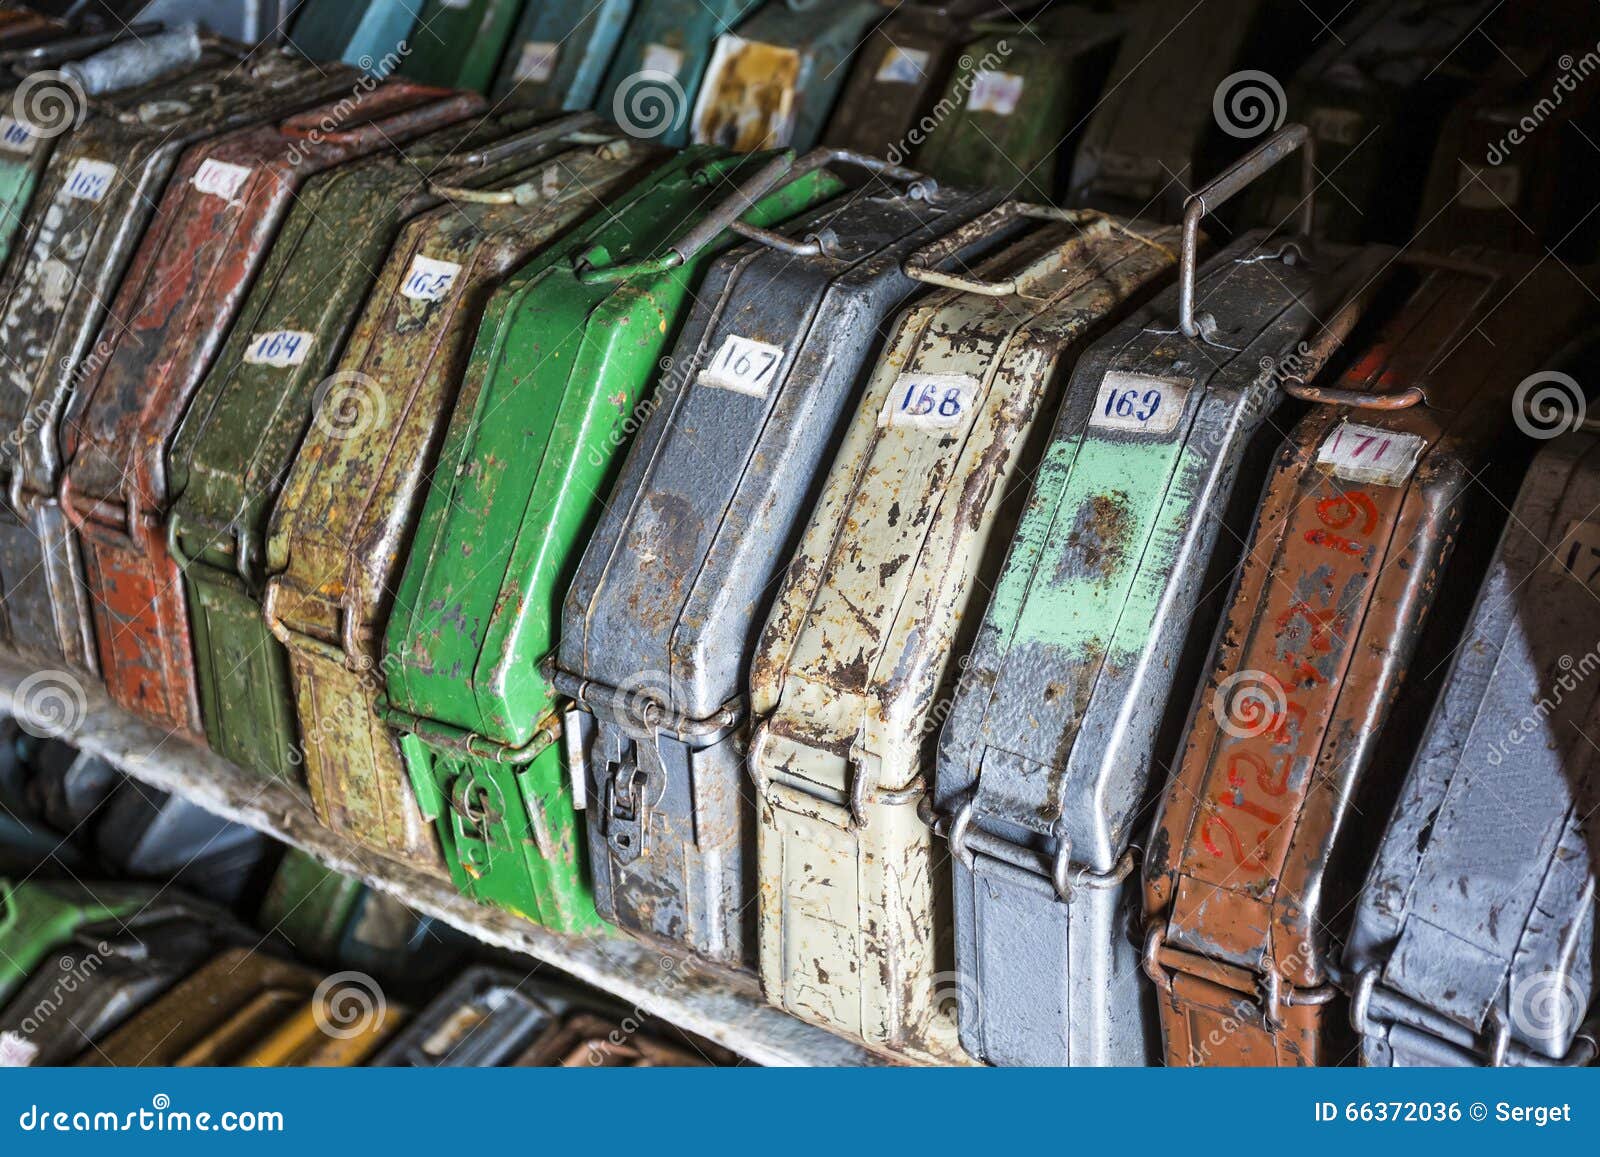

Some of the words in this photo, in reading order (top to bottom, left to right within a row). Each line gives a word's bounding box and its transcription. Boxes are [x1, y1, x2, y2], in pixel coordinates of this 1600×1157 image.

[405, 270, 451, 296] 165
[257, 332, 302, 360] 164
[721, 342, 777, 384] 167
[901, 383, 961, 417] 168
[1104, 388, 1162, 421] 169
[1331, 429, 1392, 462] 171
